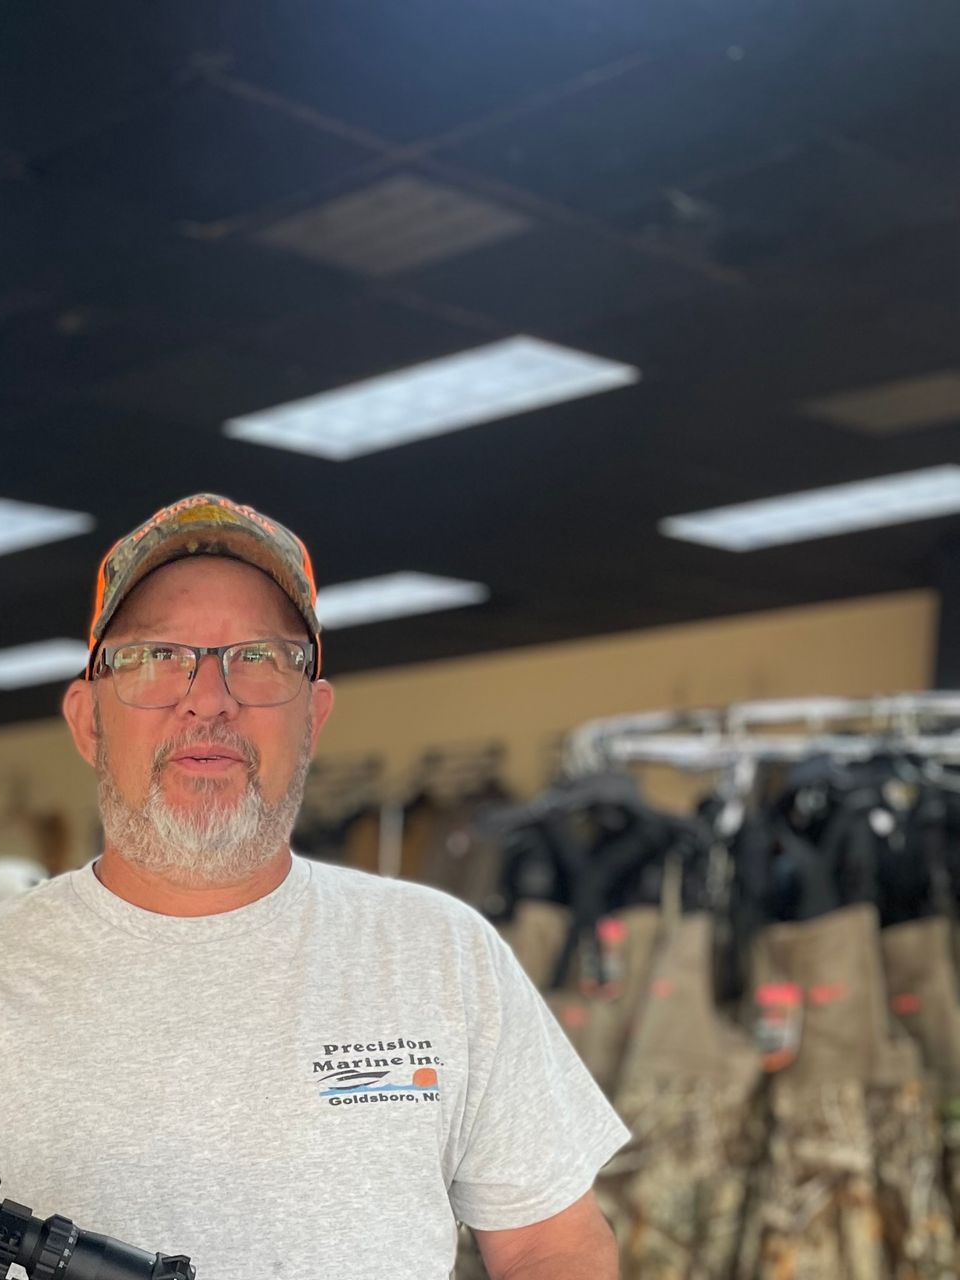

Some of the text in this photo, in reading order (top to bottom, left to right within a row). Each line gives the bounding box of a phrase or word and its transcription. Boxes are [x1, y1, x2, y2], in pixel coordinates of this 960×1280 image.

[322, 1038, 433, 1055] Precision
[312, 1054, 444, 1073] Marine Inc.
[328, 1093, 419, 1106] Goldsboro,
